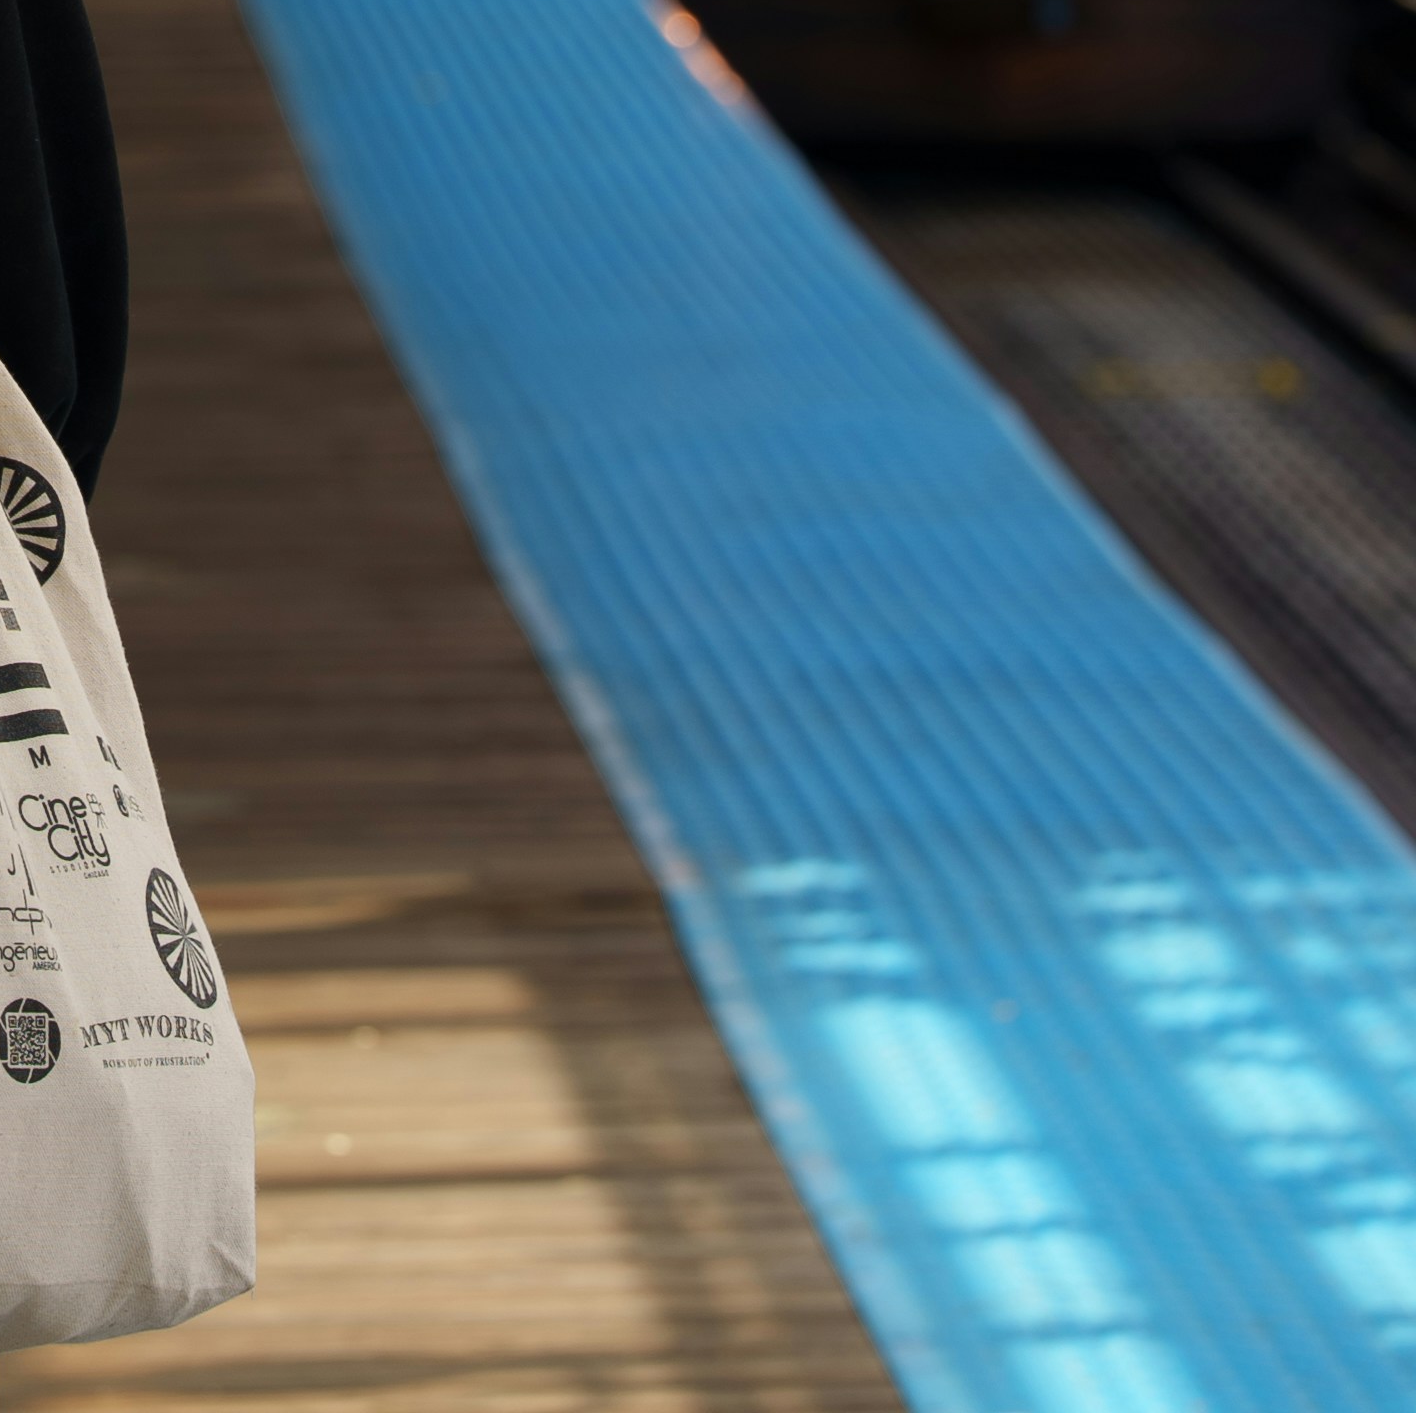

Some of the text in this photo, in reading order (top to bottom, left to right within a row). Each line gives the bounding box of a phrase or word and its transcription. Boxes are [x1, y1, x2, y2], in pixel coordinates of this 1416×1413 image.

[28, 744, 52, 769] M
[18, 793, 87, 832] Cine
[47, 816, 111, 867] City
[79, 1014, 214, 1049] MYT WORKS
[102, 1055, 206, 1069] BORN OUT OF FRUSTRATION
